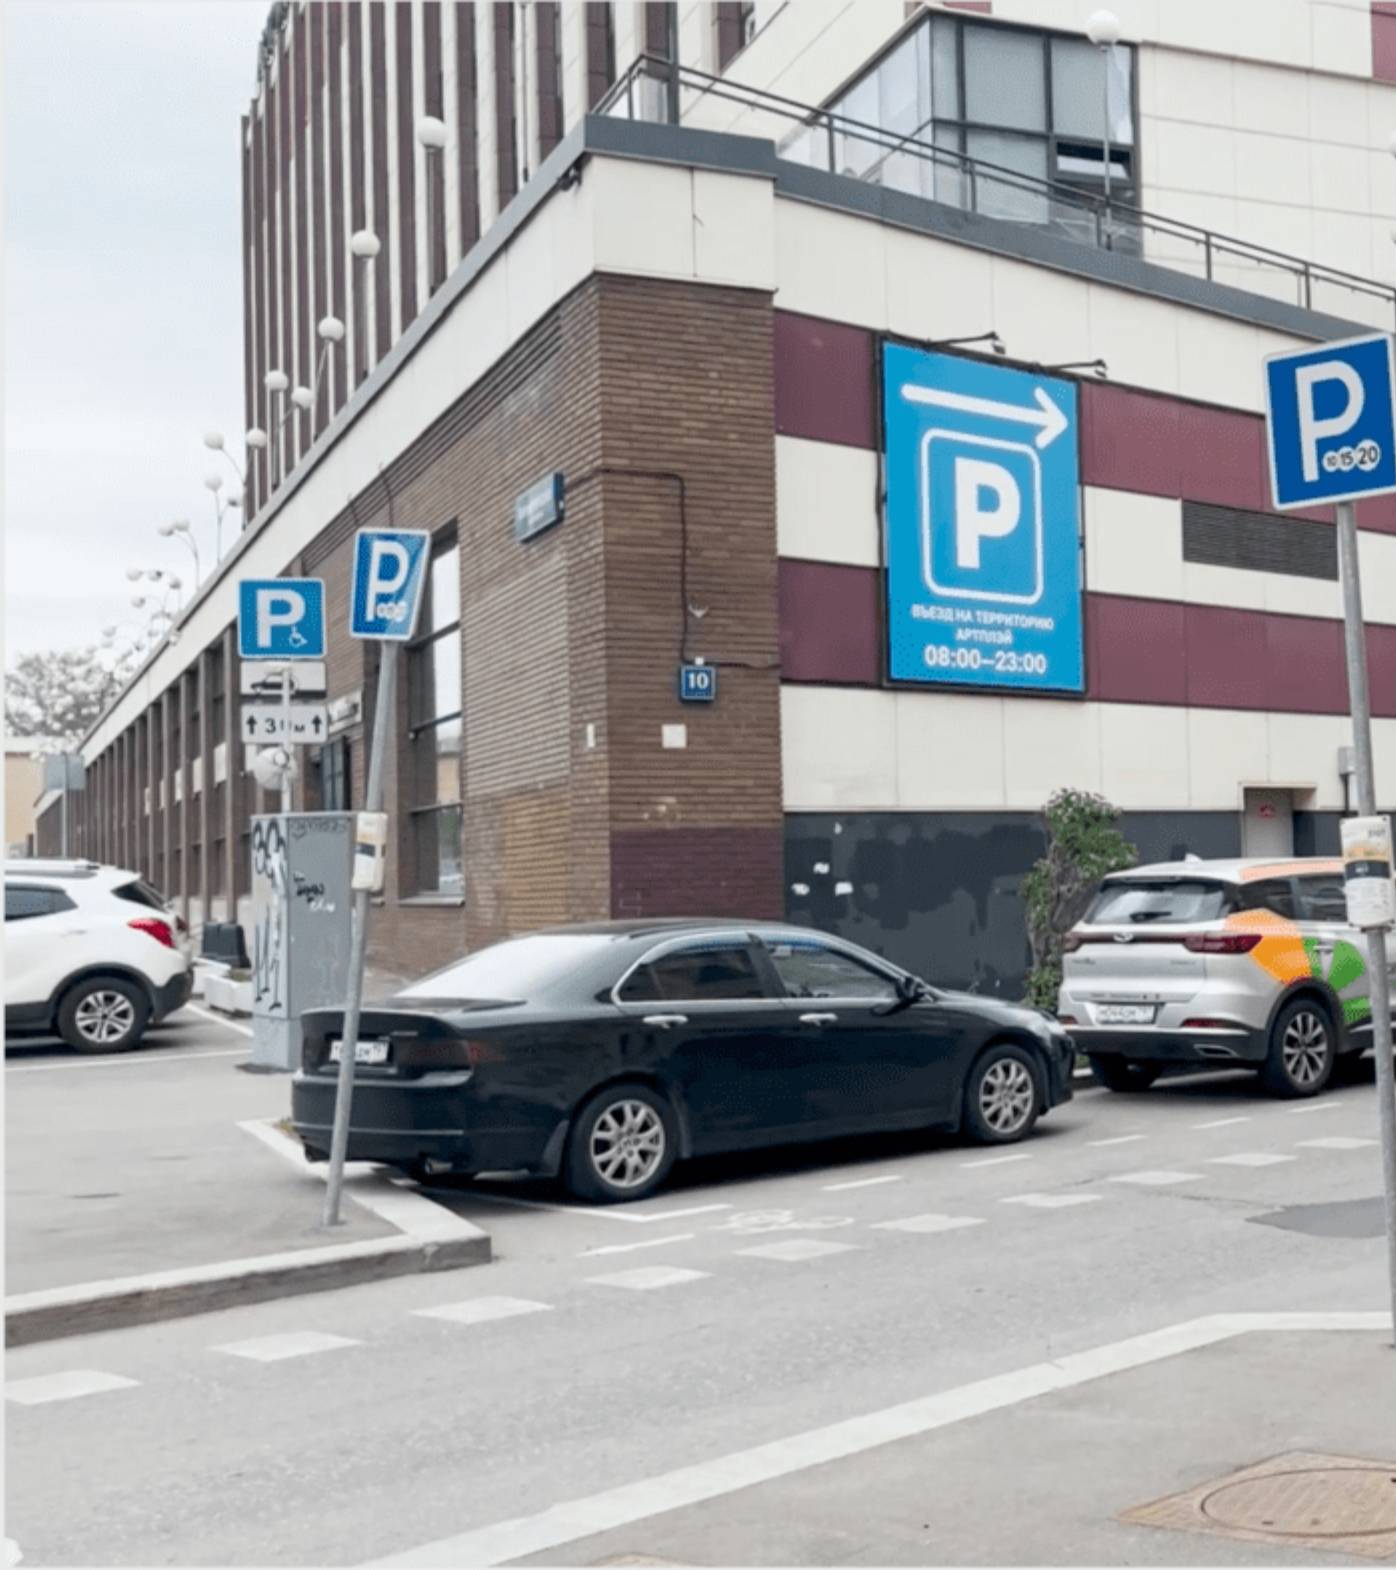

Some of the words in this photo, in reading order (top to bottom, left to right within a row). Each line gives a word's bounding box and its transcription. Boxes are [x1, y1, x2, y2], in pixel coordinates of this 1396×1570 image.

[1295, 360, 1365, 483] P
[1340, 452, 1354, 465] 15
[1358, 446, 1378, 465] 20
[955, 456, 1020, 569] P
[366, 541, 410, 622] P
[256, 588, 306, 648] P
[911, 603, 954, 623] ВЪЕЗД
[955, 609, 973, 623] НА
[976, 611, 1055, 631] ТЕРРИТОРИЮ
[955, 627, 1014, 645] АРТПЛЭЙ
[688, 672, 710, 690] 10
